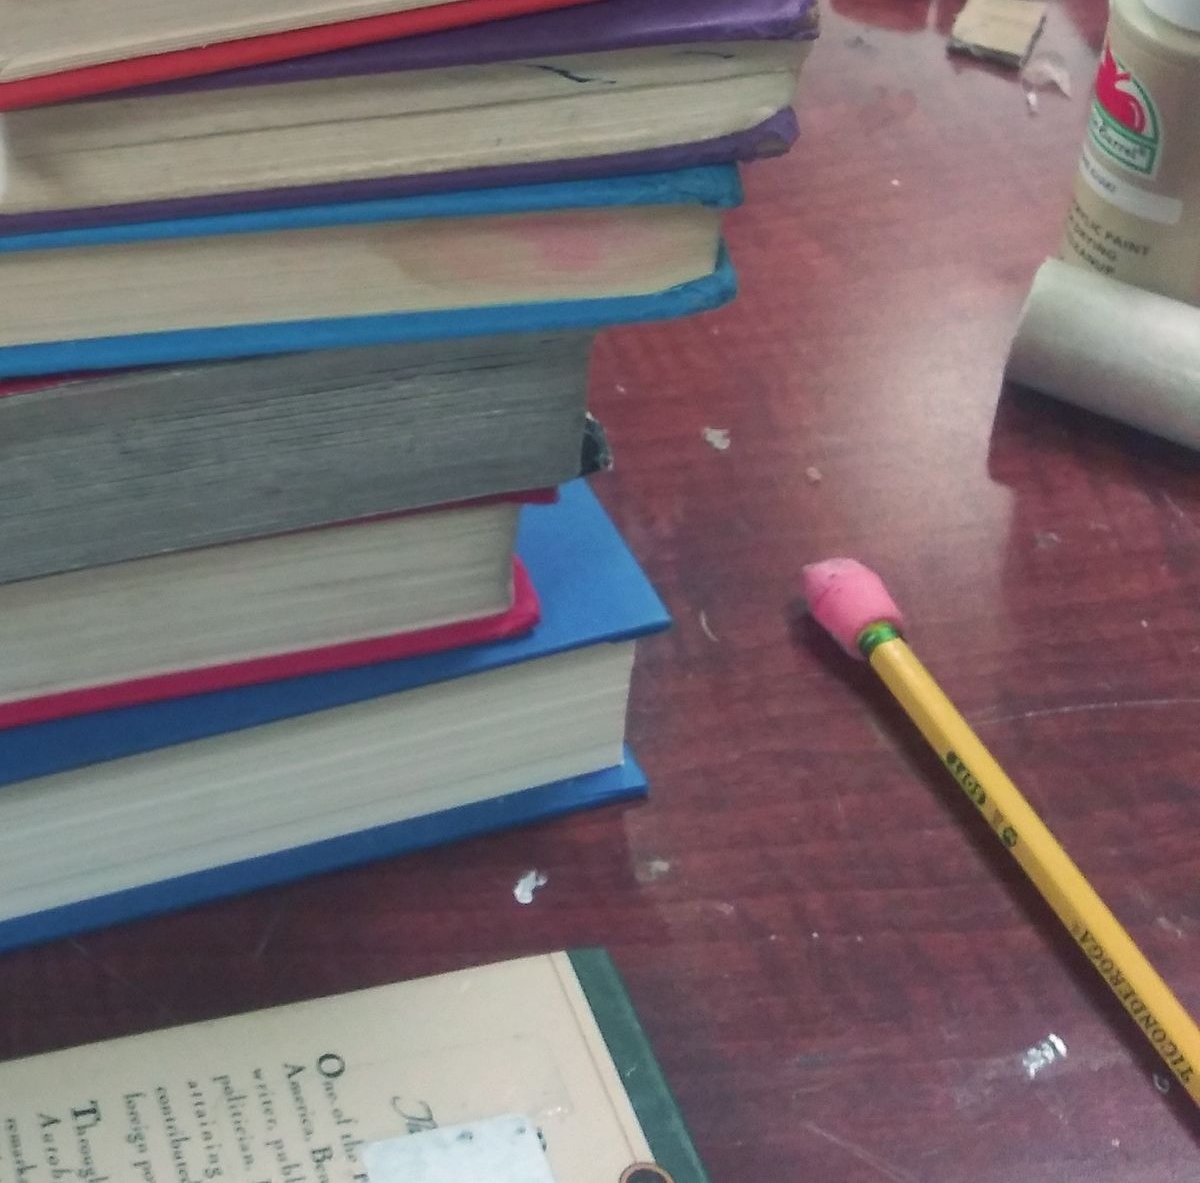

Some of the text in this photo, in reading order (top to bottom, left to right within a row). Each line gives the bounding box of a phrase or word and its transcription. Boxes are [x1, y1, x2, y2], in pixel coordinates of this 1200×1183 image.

[1078, 927, 1192, 1085] TICONDEROGA
[123, 1092, 148, 1155] foreign
[187, 1080, 224, 1180] attaining
[316, 1053, 346, 1106] One
[341, 1134, 364, 1162] the
